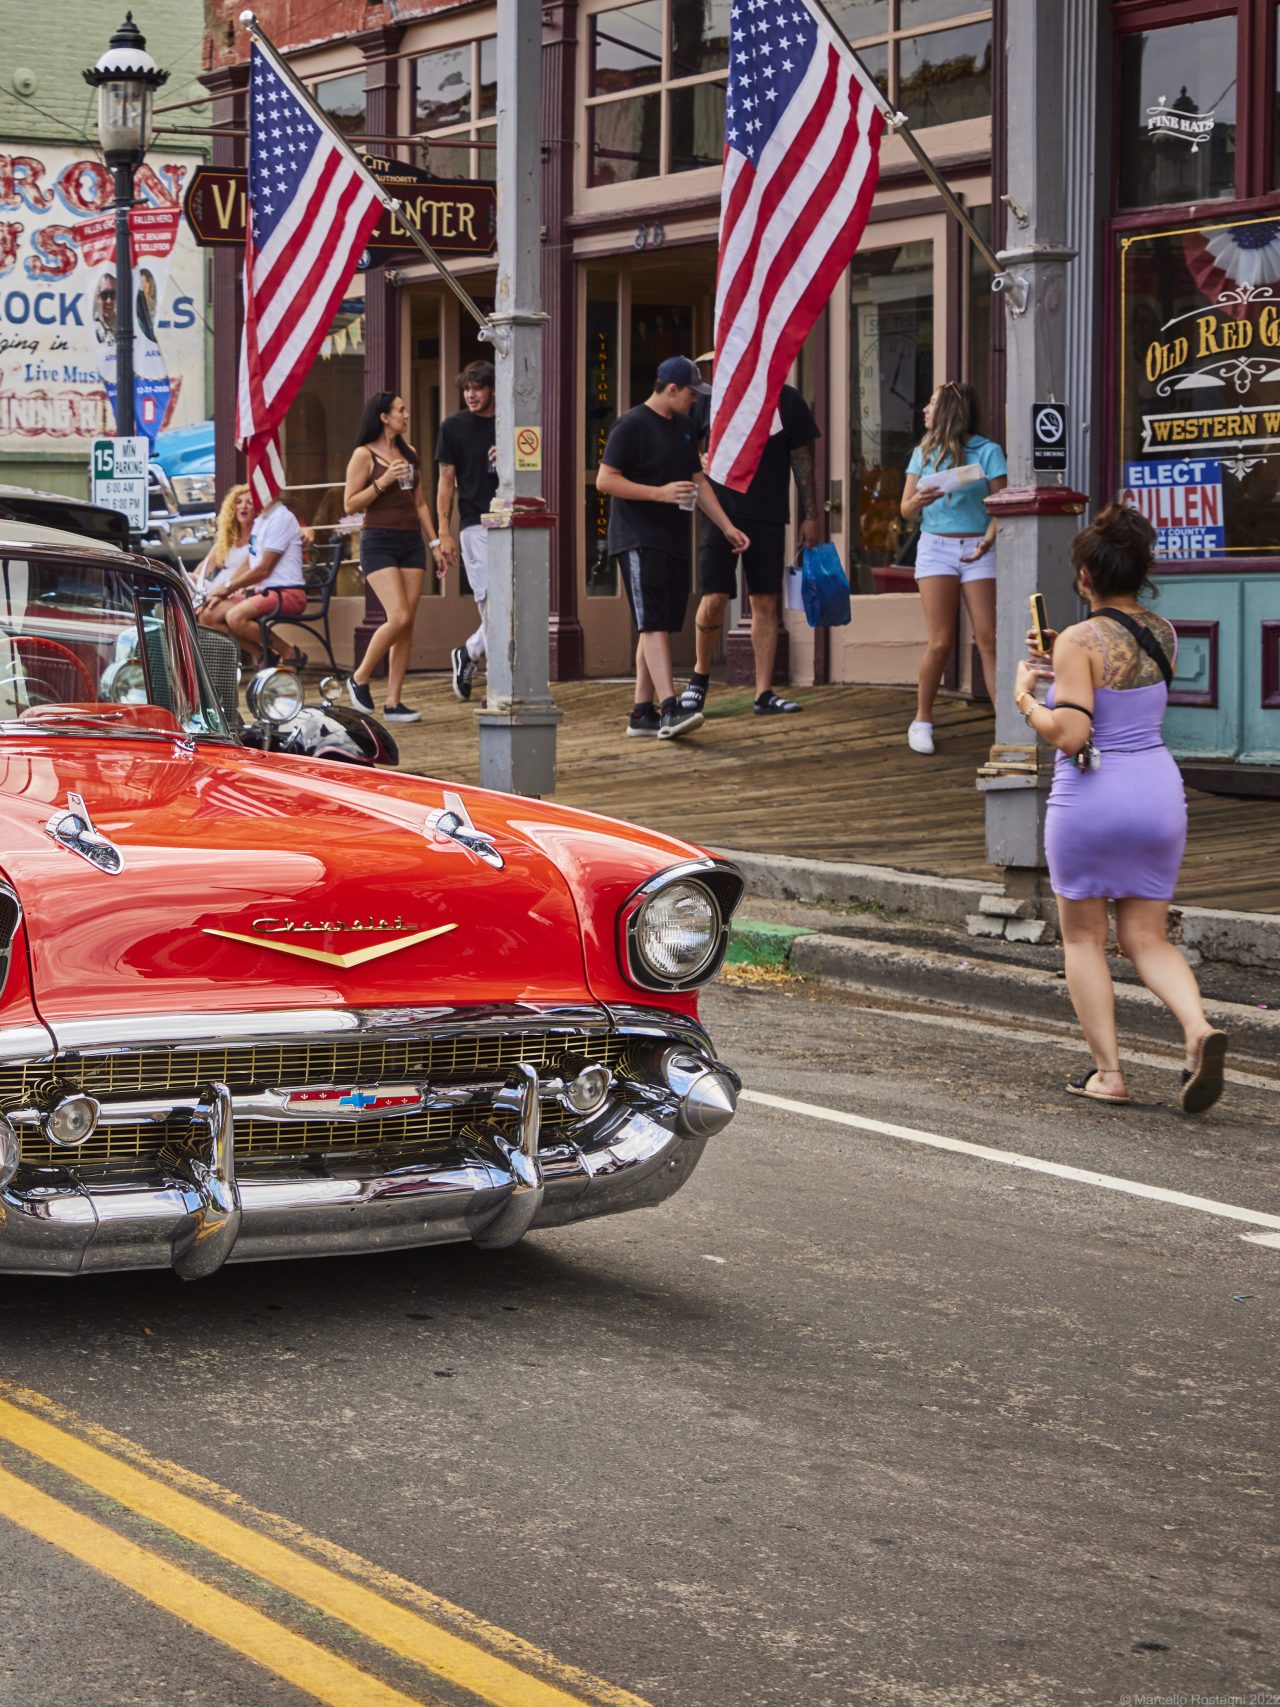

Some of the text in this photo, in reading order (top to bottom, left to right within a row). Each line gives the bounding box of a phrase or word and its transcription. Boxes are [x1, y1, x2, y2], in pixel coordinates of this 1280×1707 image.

[1147, 115, 1215, 133] FINE HATS
[133, 214, 173, 224] FALLEN HERO
[373, 195, 477, 242] ENTER
[50, 335, 70, 351] in
[1146, 336, 1189, 382] OLD
[1196, 315, 1253, 358] RED
[24, 359, 59, 383] Live
[63, 365, 105, 385] Musi
[597, 332, 609, 401] VISITOR
[1153, 412, 1280, 442] WESTERN W
[95, 443, 136, 472] 15 MIN
[116, 460, 144, 475] PARKING
[1128, 462, 1207, 486] ELECT
[123, 481, 134, 493] AM
[129, 497, 140, 509] PM
[1168, 527, 1207, 536] COUNTY
[1154, 534, 1217, 559] ERIFF
[252, 915, 418, 933] Chevrolet
